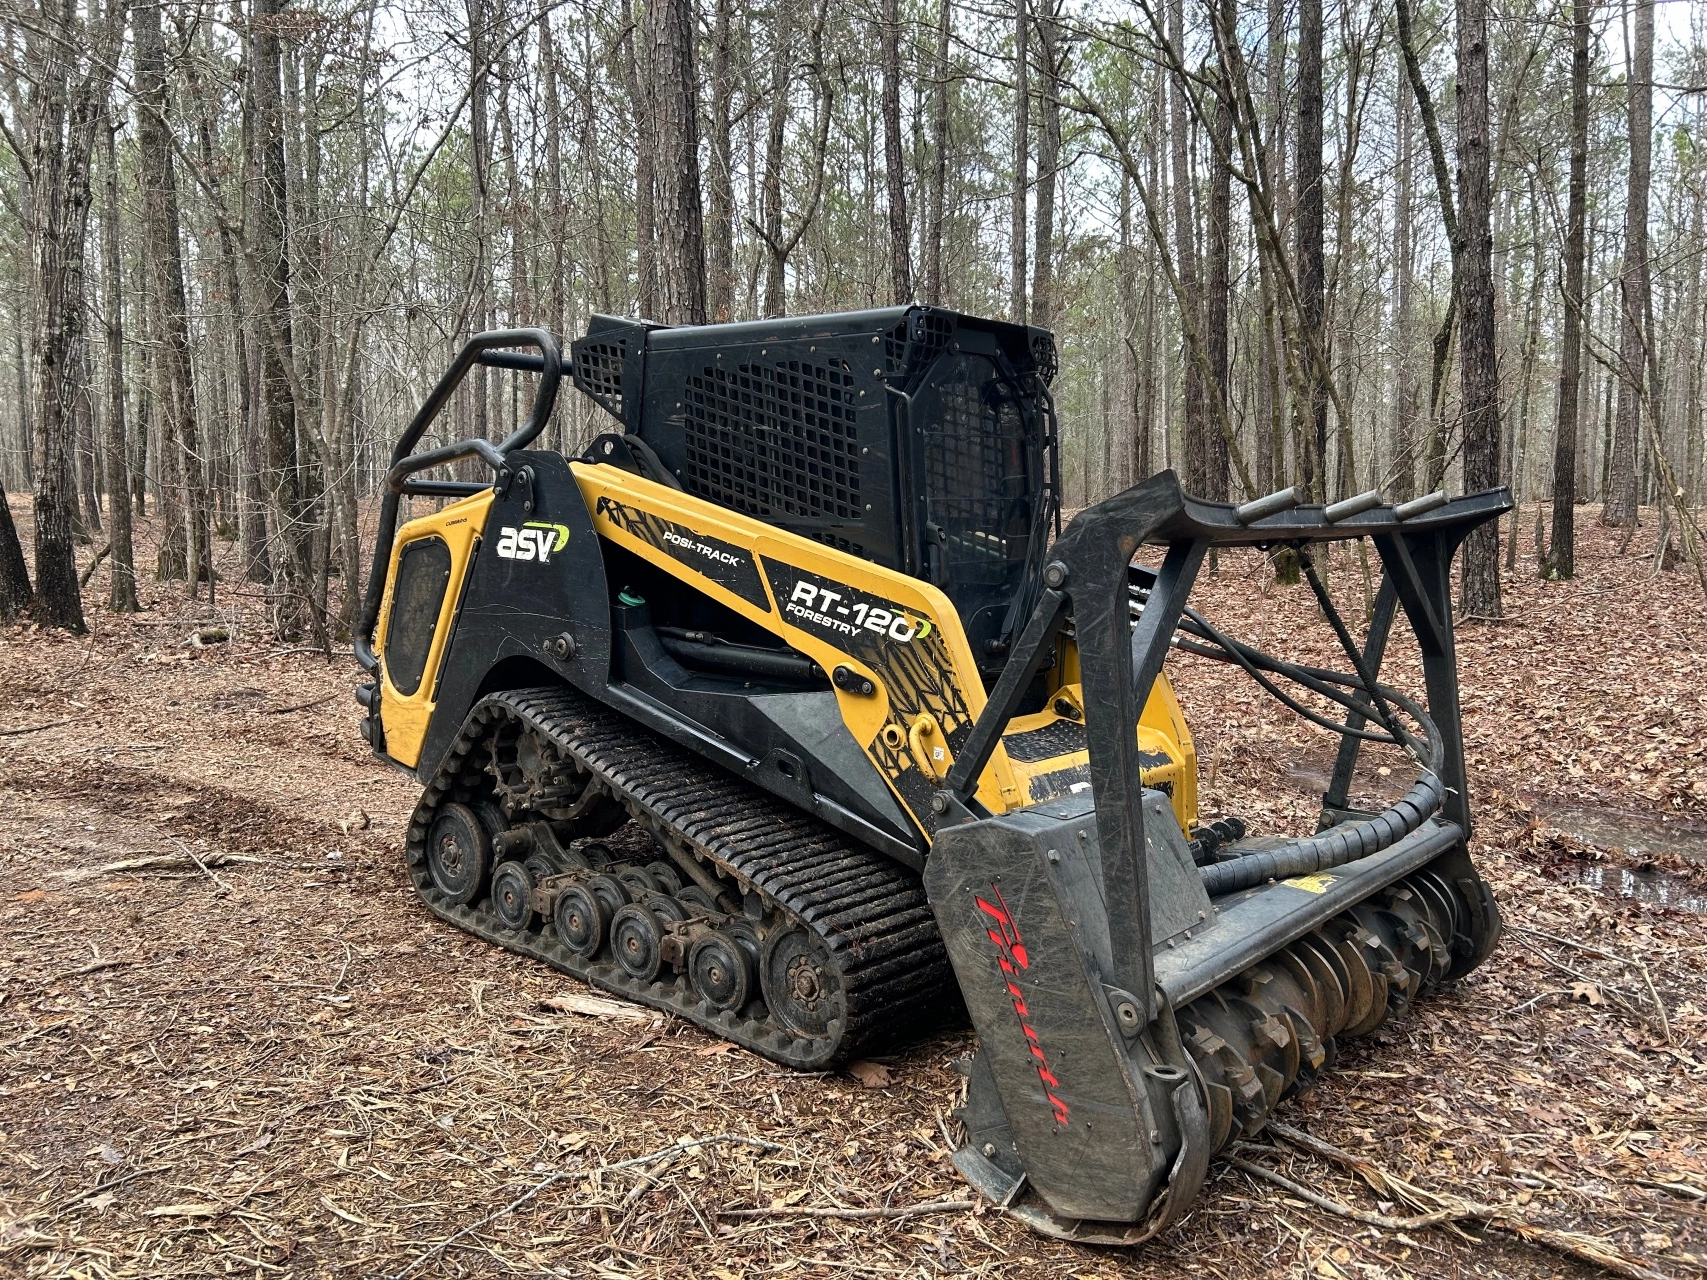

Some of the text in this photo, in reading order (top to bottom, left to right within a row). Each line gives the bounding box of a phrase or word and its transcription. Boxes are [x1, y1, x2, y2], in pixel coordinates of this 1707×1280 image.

[663, 531, 740, 567] POSI-TRACK
[786, 602, 862, 637] FORESTRY
[790, 580, 916, 643] RT-120
